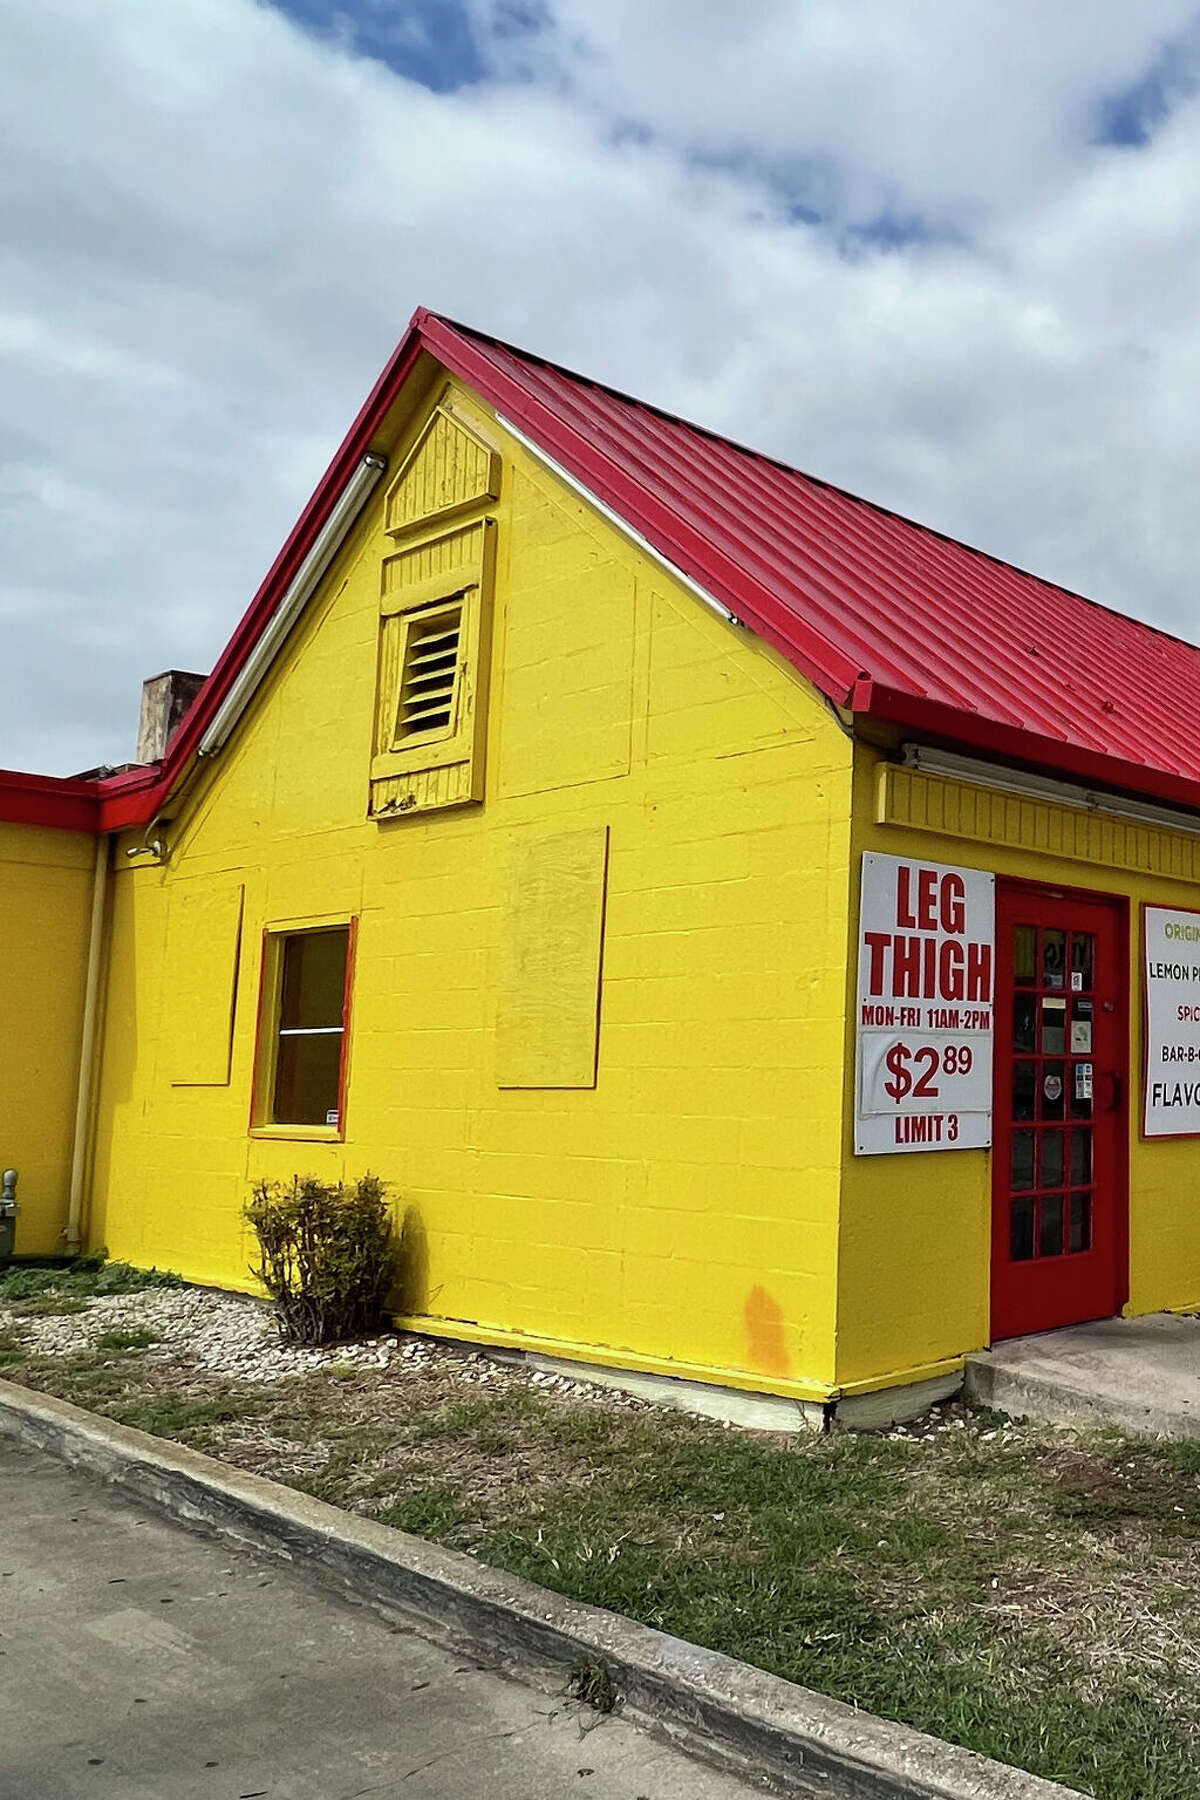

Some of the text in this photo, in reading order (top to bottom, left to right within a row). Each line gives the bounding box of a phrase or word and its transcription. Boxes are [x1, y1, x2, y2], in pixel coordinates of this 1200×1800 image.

[897, 865, 966, 935] LEG
[864, 932, 991, 1003] THIGH
[1149, 962, 1189, 981] LEMON
[861, 1004, 990, 1030] MON-FRI 11AM-2PM
[894, 1114, 958, 1144] LIMIT 3
